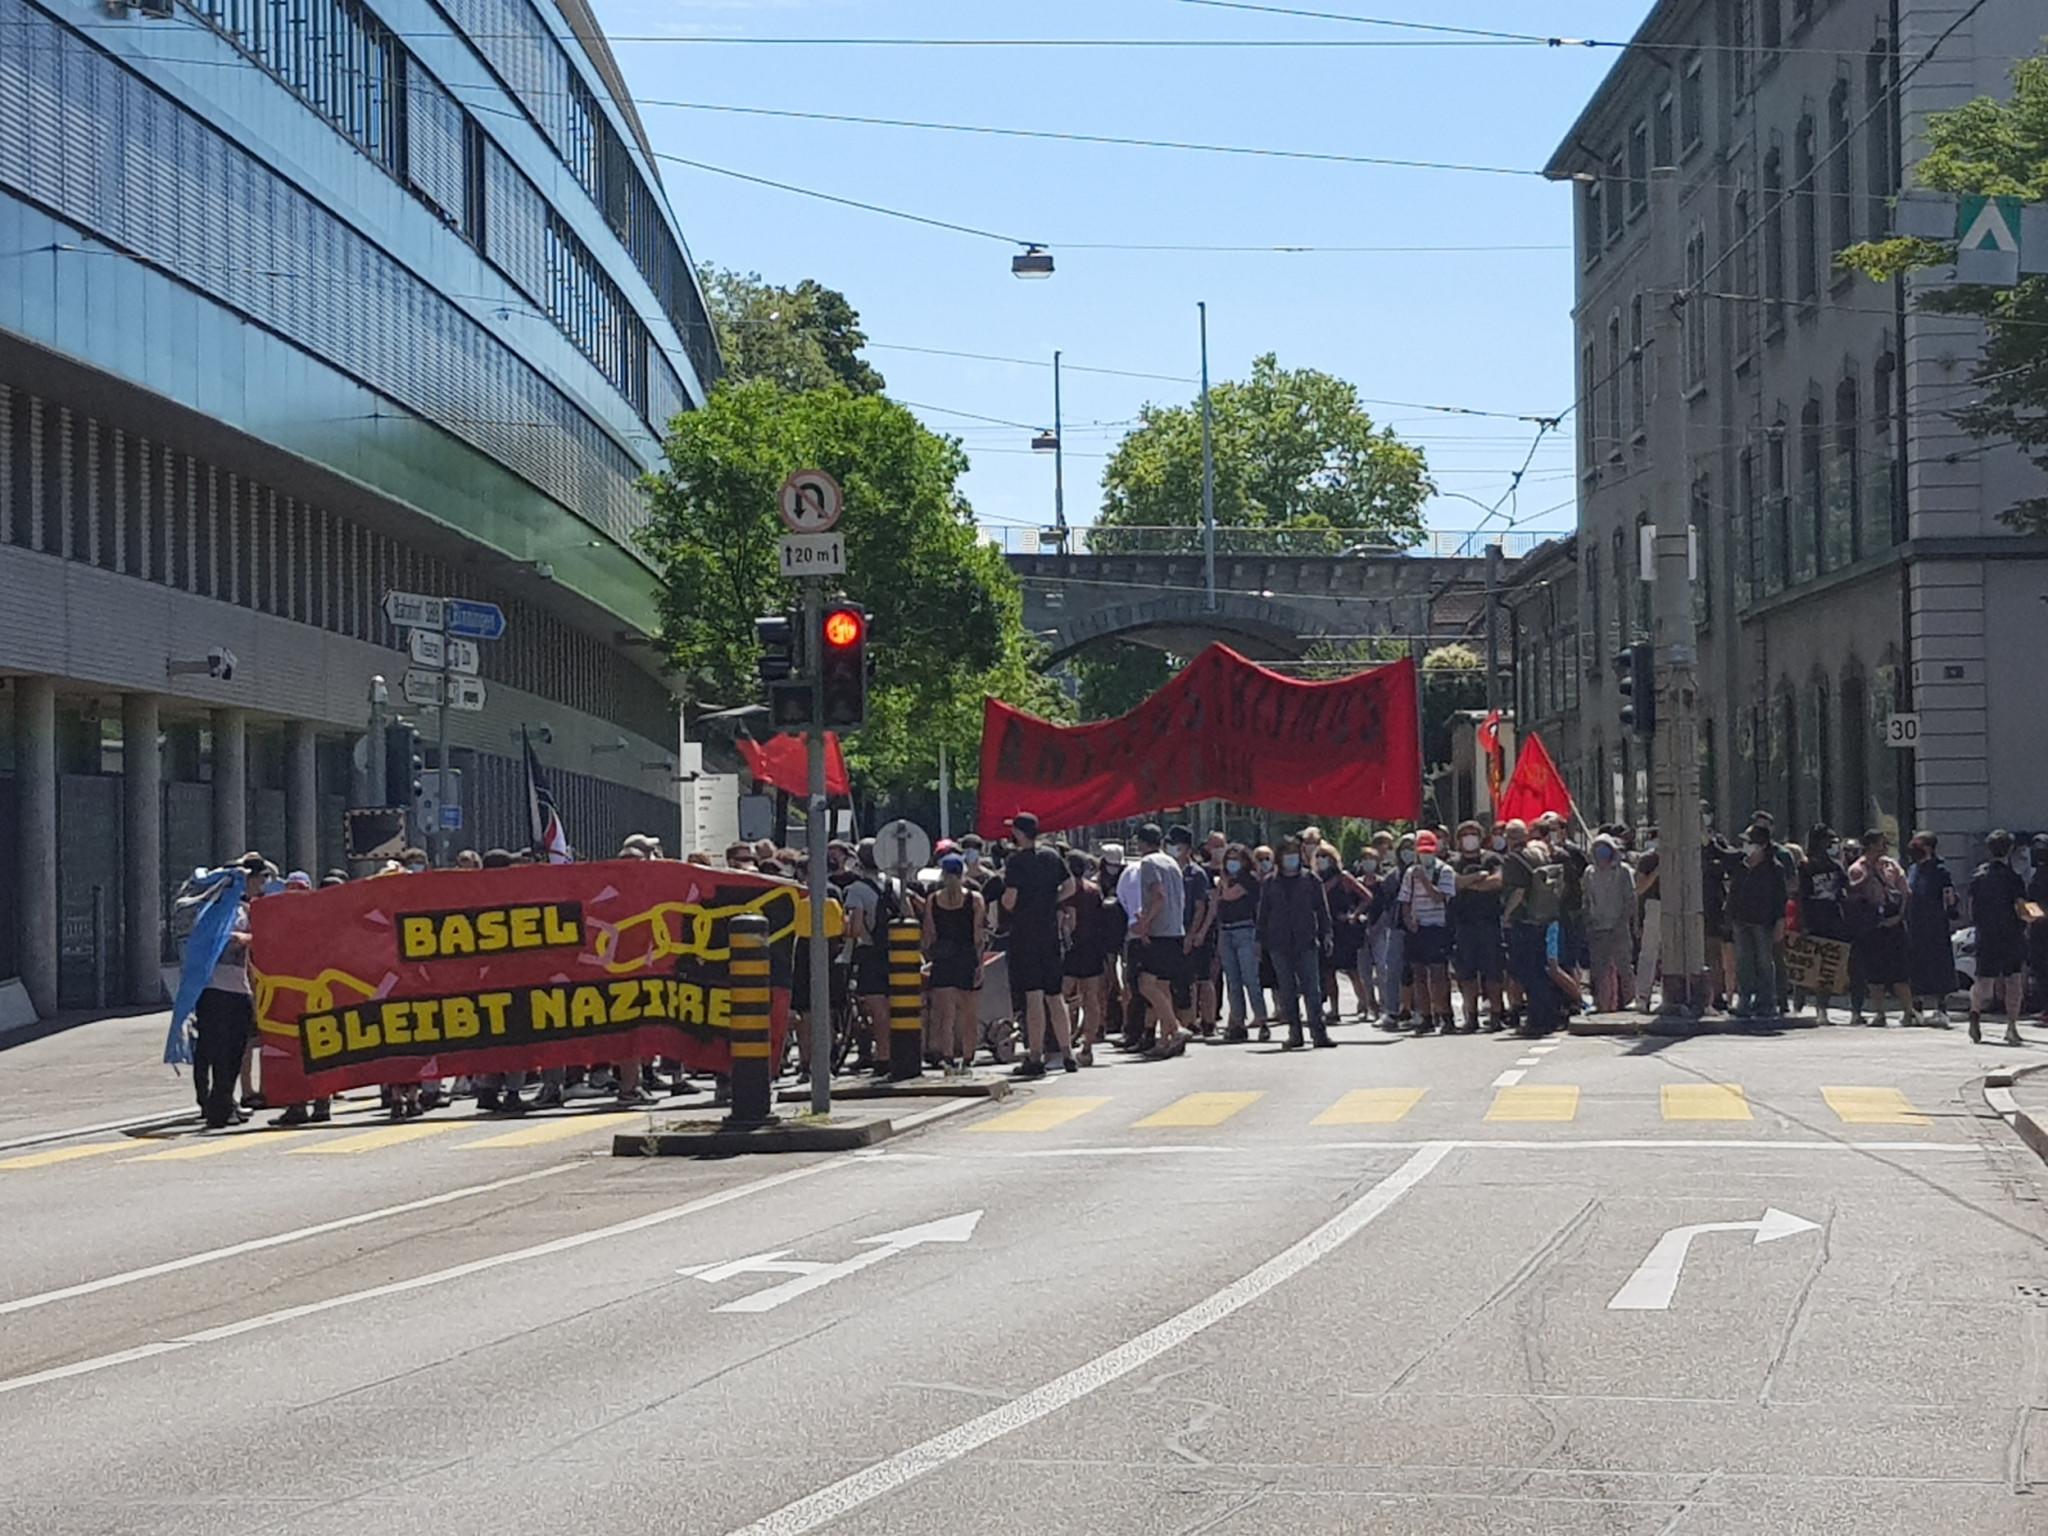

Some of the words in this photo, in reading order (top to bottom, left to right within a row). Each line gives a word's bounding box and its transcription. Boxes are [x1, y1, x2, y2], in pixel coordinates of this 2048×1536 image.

[795, 547, 813, 563] 20
[817, 550, 830, 562] m
[1891, 720, 1917, 740] 30
[403, 905, 579, 957] BASEL
[305, 992, 513, 1060] BLEIBT
[530, 979, 732, 1030] NAZIFRE
